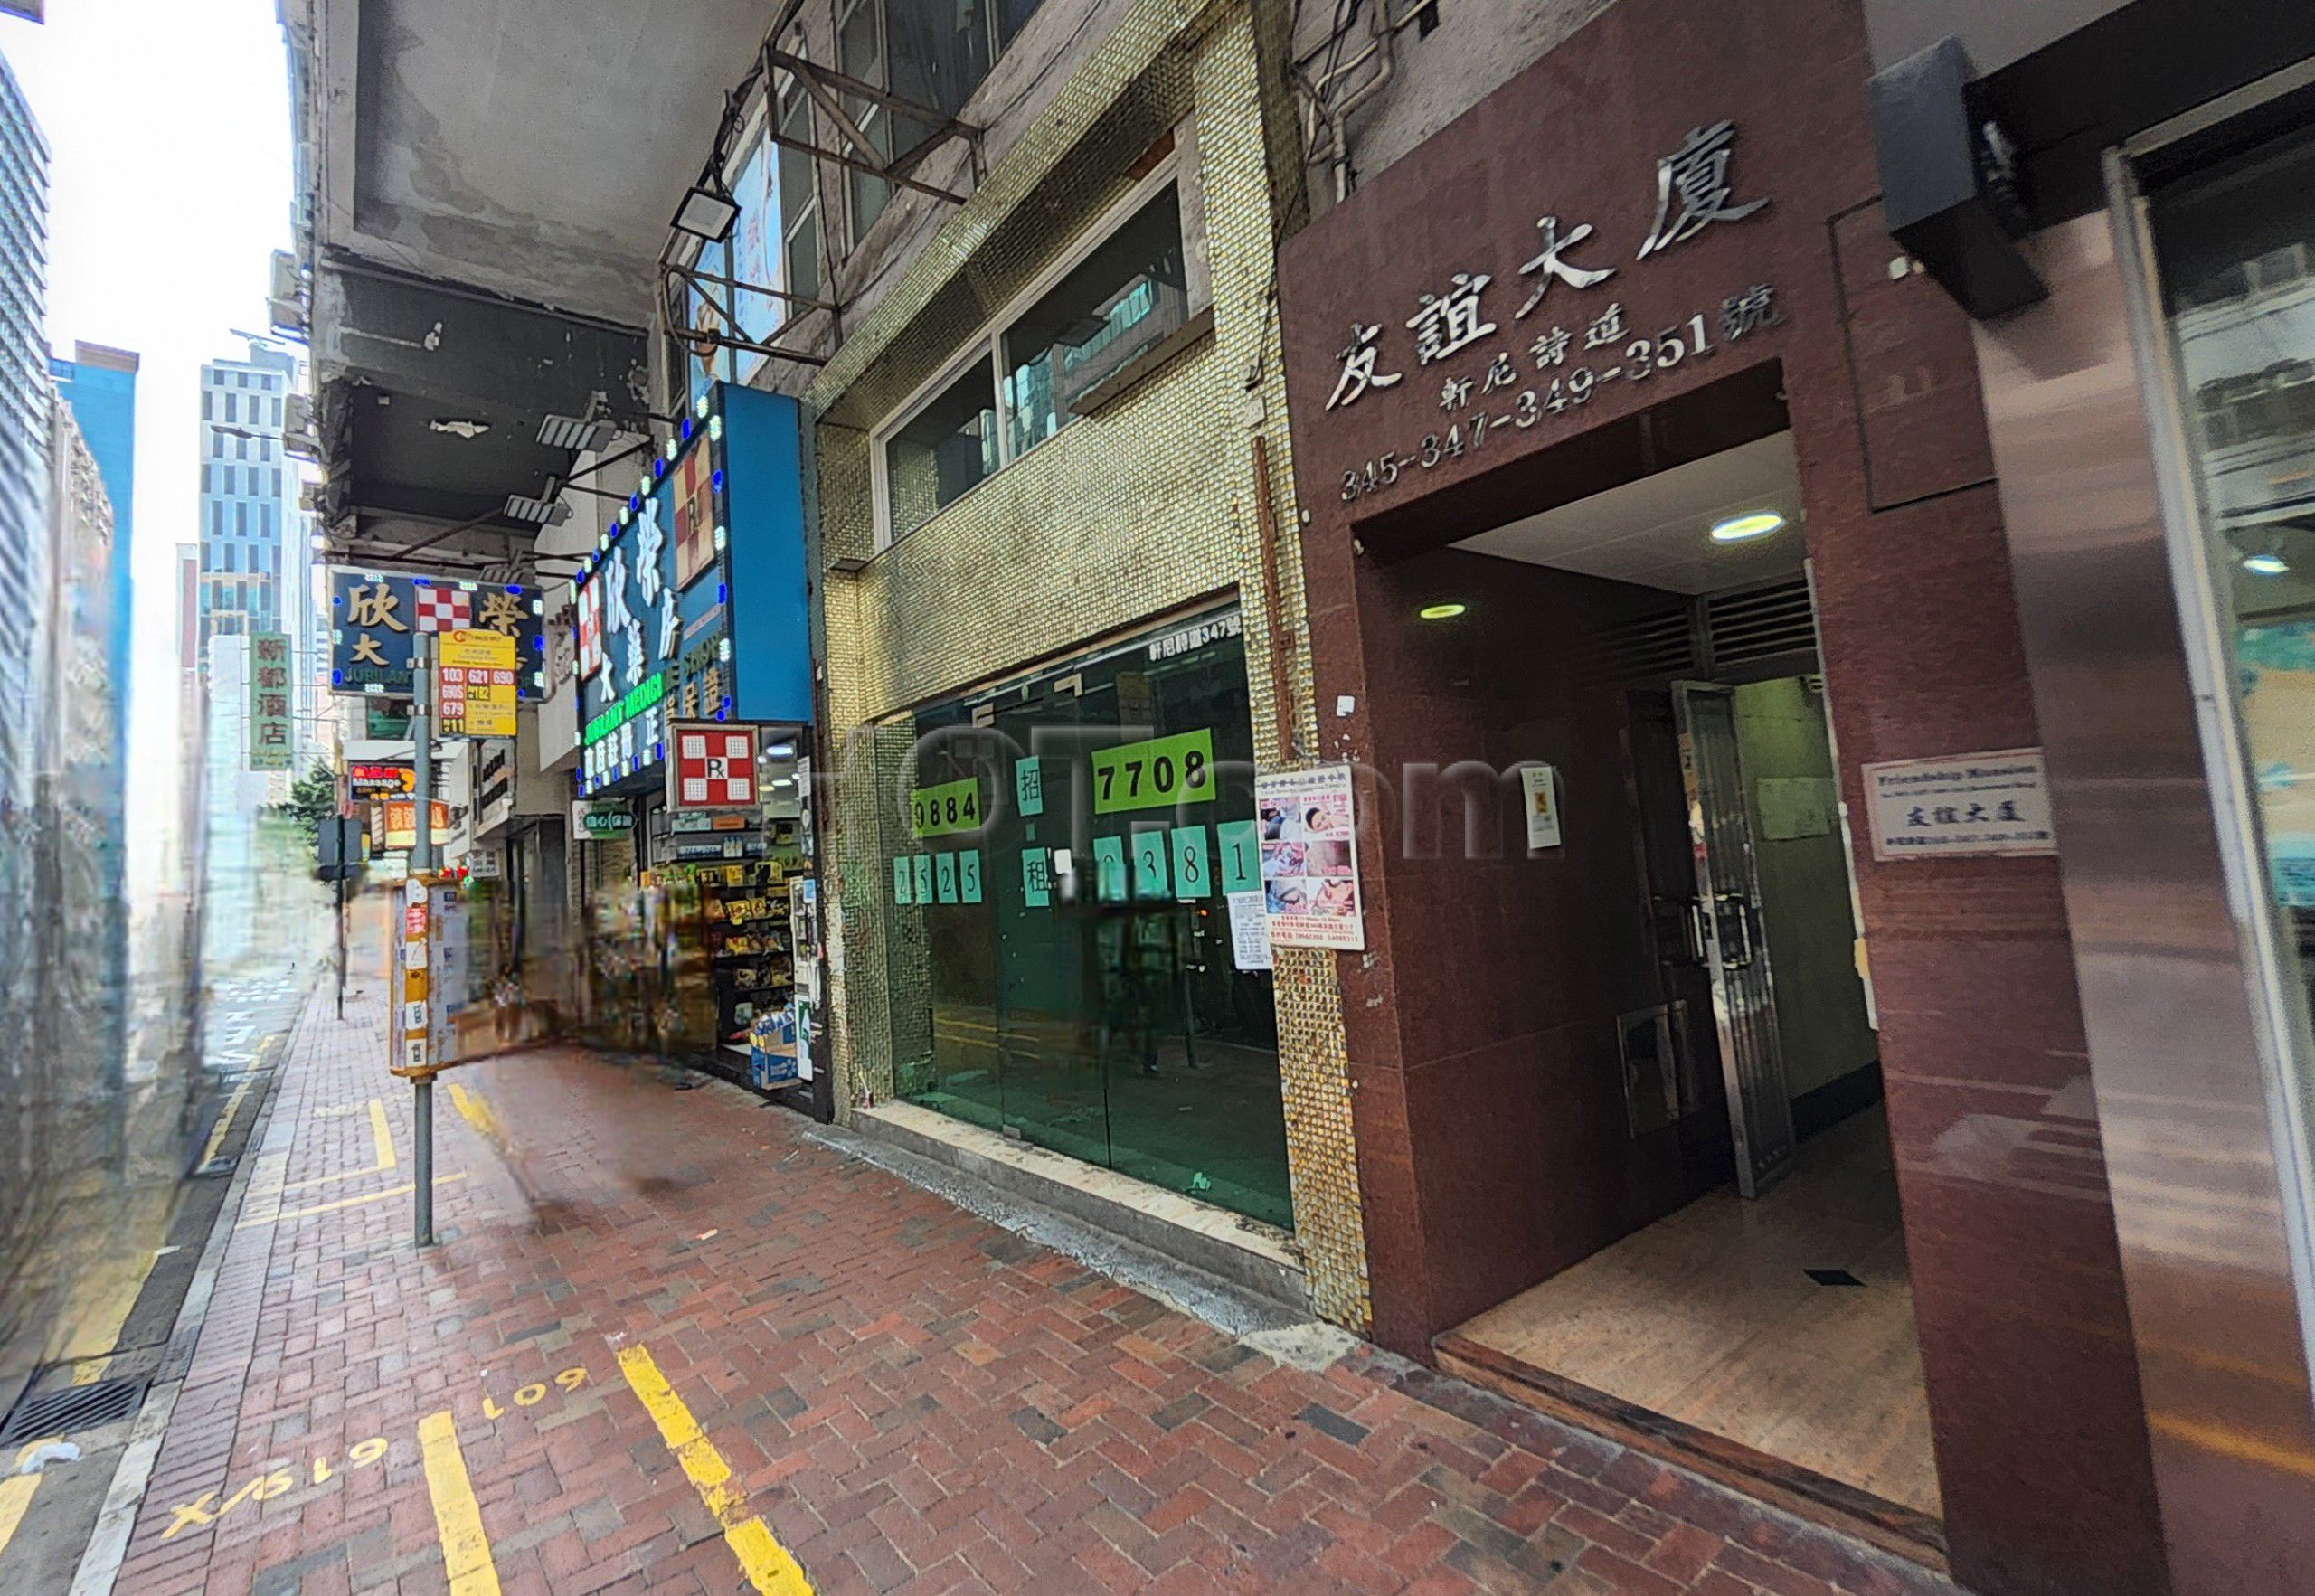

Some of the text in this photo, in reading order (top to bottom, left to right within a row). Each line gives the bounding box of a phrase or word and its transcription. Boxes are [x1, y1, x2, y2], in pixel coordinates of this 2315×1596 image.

[1325, 119, 1770, 411] 友誼大廈
[1439, 302, 1631, 411] 軒尼詩道
[346, 583, 410, 631] 欣
[349, 633, 390, 666] 大
[257, 637, 288, 745] 新都酒店
[442, 701, 464, 716] 679
[1097, 750, 1208, 801] 7708
[914, 790, 976, 830] 9884
